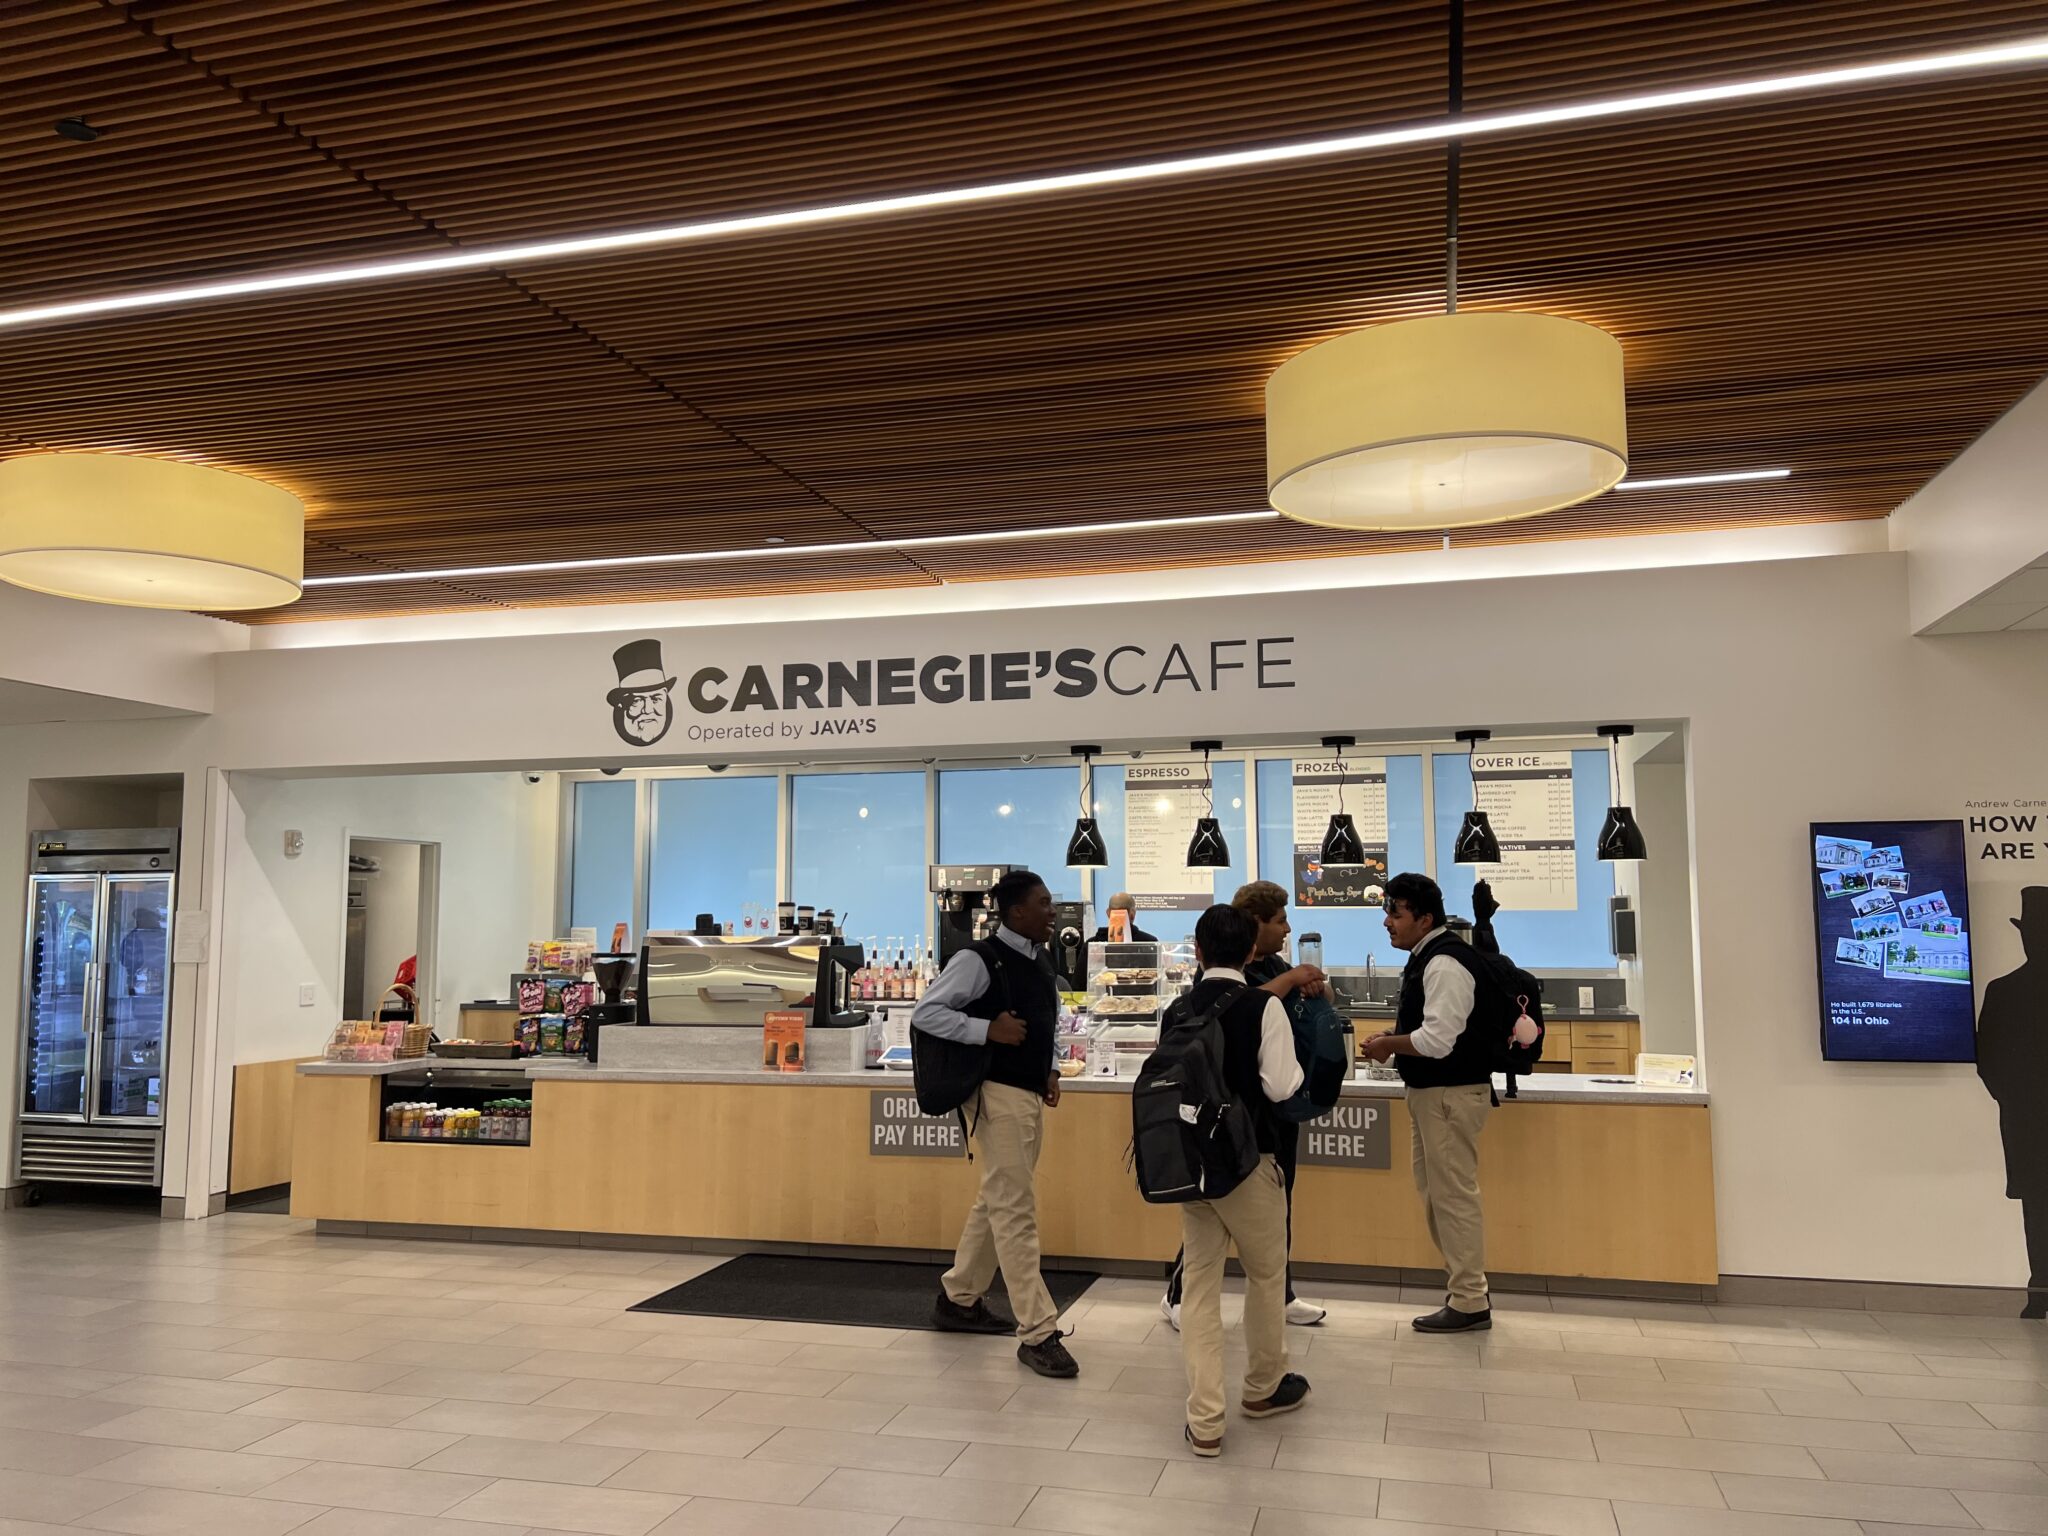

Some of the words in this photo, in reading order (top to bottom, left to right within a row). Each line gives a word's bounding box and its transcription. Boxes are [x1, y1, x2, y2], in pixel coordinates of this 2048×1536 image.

[688, 648, 1098, 714] CARNEGIE'S
[1103, 637, 1296, 696] CAFE
[687, 721, 774, 743] Operated
[782, 720, 804, 740] by
[809, 717, 877, 736] JAVA'S
[1296, 762, 1348, 773] FROZEN
[1476, 757, 1514, 768] OVER
[1518, 756, 1540, 767] ICE
[1128, 767, 1190, 778] ESPRESSO
[1965, 799, 2009, 808] Andrew
[2013, 799, 2048, 808] Carne
[1969, 815, 2038, 833] HOW
[1980, 842, 2036, 860] ARE
[1832, 1016, 1850, 1025] 104
[883, 1097, 951, 1119] ORD
[1309, 1106, 1378, 1129] CKUP
[874, 1124, 907, 1146] PAY
[913, 1125, 960, 1147] HERE
[1308, 1132, 1366, 1158] HERE
